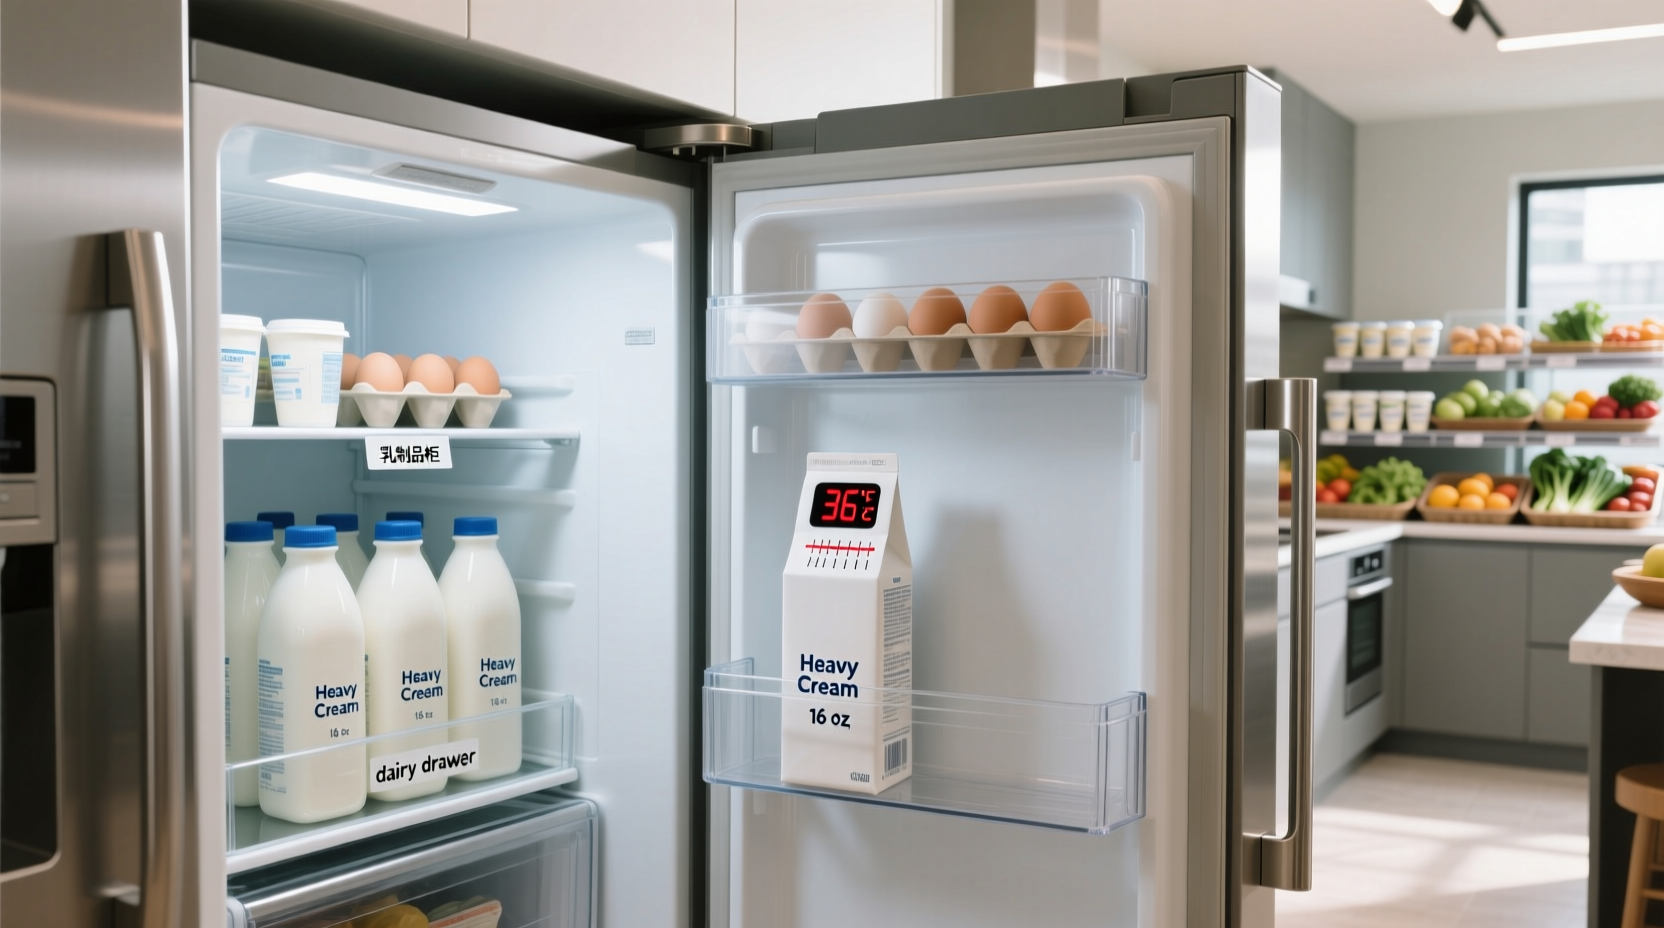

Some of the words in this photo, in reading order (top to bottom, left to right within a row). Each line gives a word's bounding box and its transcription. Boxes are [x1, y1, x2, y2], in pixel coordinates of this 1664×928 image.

[821, 489, 859, 522] 36
[800, 653, 859, 680] Heavy
[315, 684, 357, 700] Heavy
[797, 675, 859, 698] Cream
[314, 702, 359, 718] Cream
[809, 708, 827, 725] 16
[830, 713, 851, 729] oz
[376, 762, 417, 783] dairy
[421, 751, 476, 773] drawer
